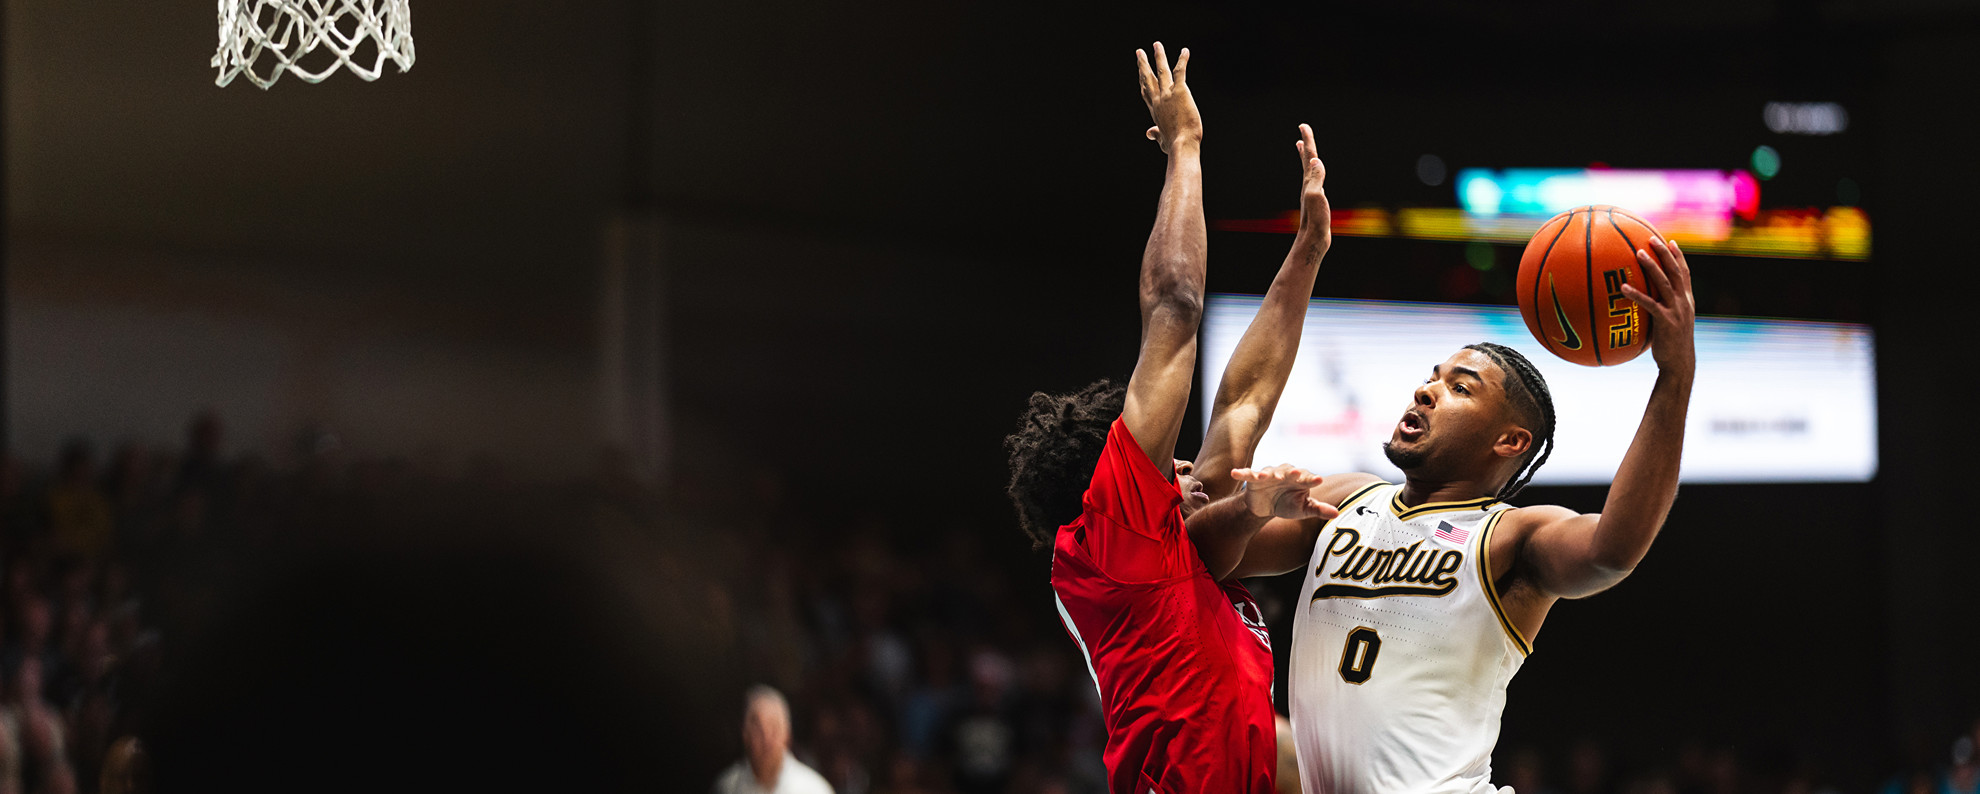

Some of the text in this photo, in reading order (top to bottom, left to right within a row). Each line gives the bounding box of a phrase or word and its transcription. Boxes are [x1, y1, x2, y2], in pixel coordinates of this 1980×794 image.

[1603, 267, 1633, 350] ELITE
[1310, 526, 1464, 600] Purdue
[1338, 625, 1382, 685] 0
